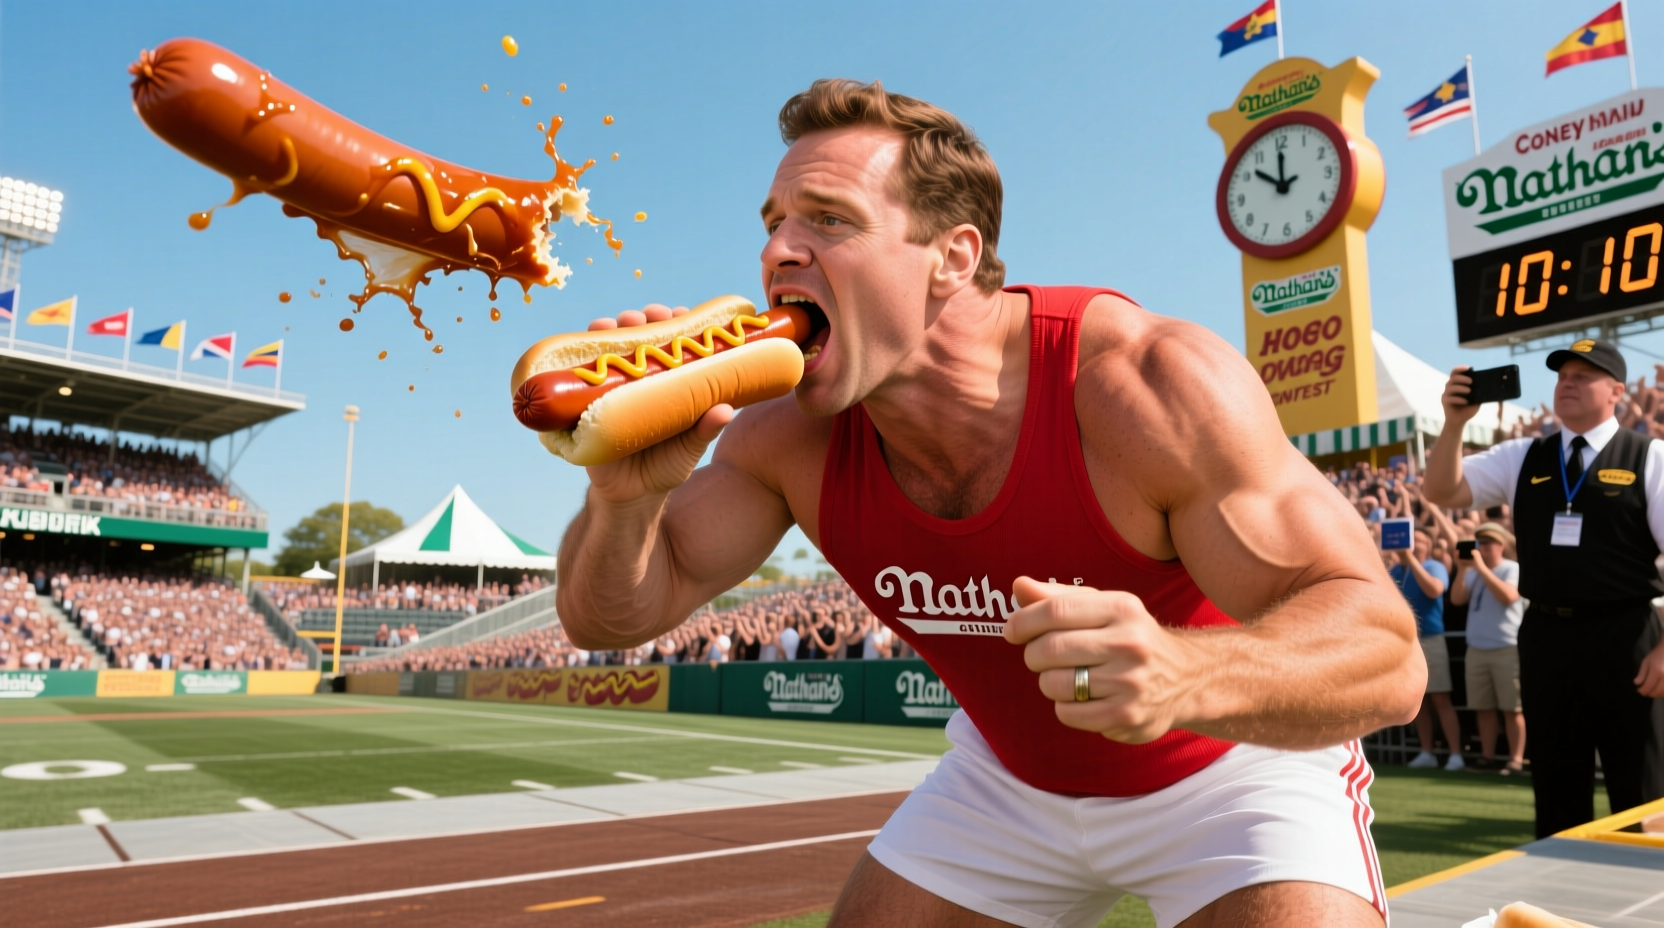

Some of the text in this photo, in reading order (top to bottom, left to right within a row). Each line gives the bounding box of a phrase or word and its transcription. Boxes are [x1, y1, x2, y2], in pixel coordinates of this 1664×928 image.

[1275, 135, 1288, 151] 12
[1301, 134, 1306, 147] 1
[1515, 119, 1584, 154] CONEY
[1255, 151, 1264, 164] 11
[1317, 147, 1325, 160] 2
[1324, 166, 1332, 179] 3
[1456, 121, 1664, 214] Nathan'
[1237, 194, 1245, 207] 9
[1318, 191, 1326, 203] 4
[1246, 213, 1254, 226] 8
[1305, 210, 1313, 223] 5
[1262, 223, 1269, 236] 7
[1283, 222, 1291, 236] 6
[875, 566, 1020, 620] Nath
